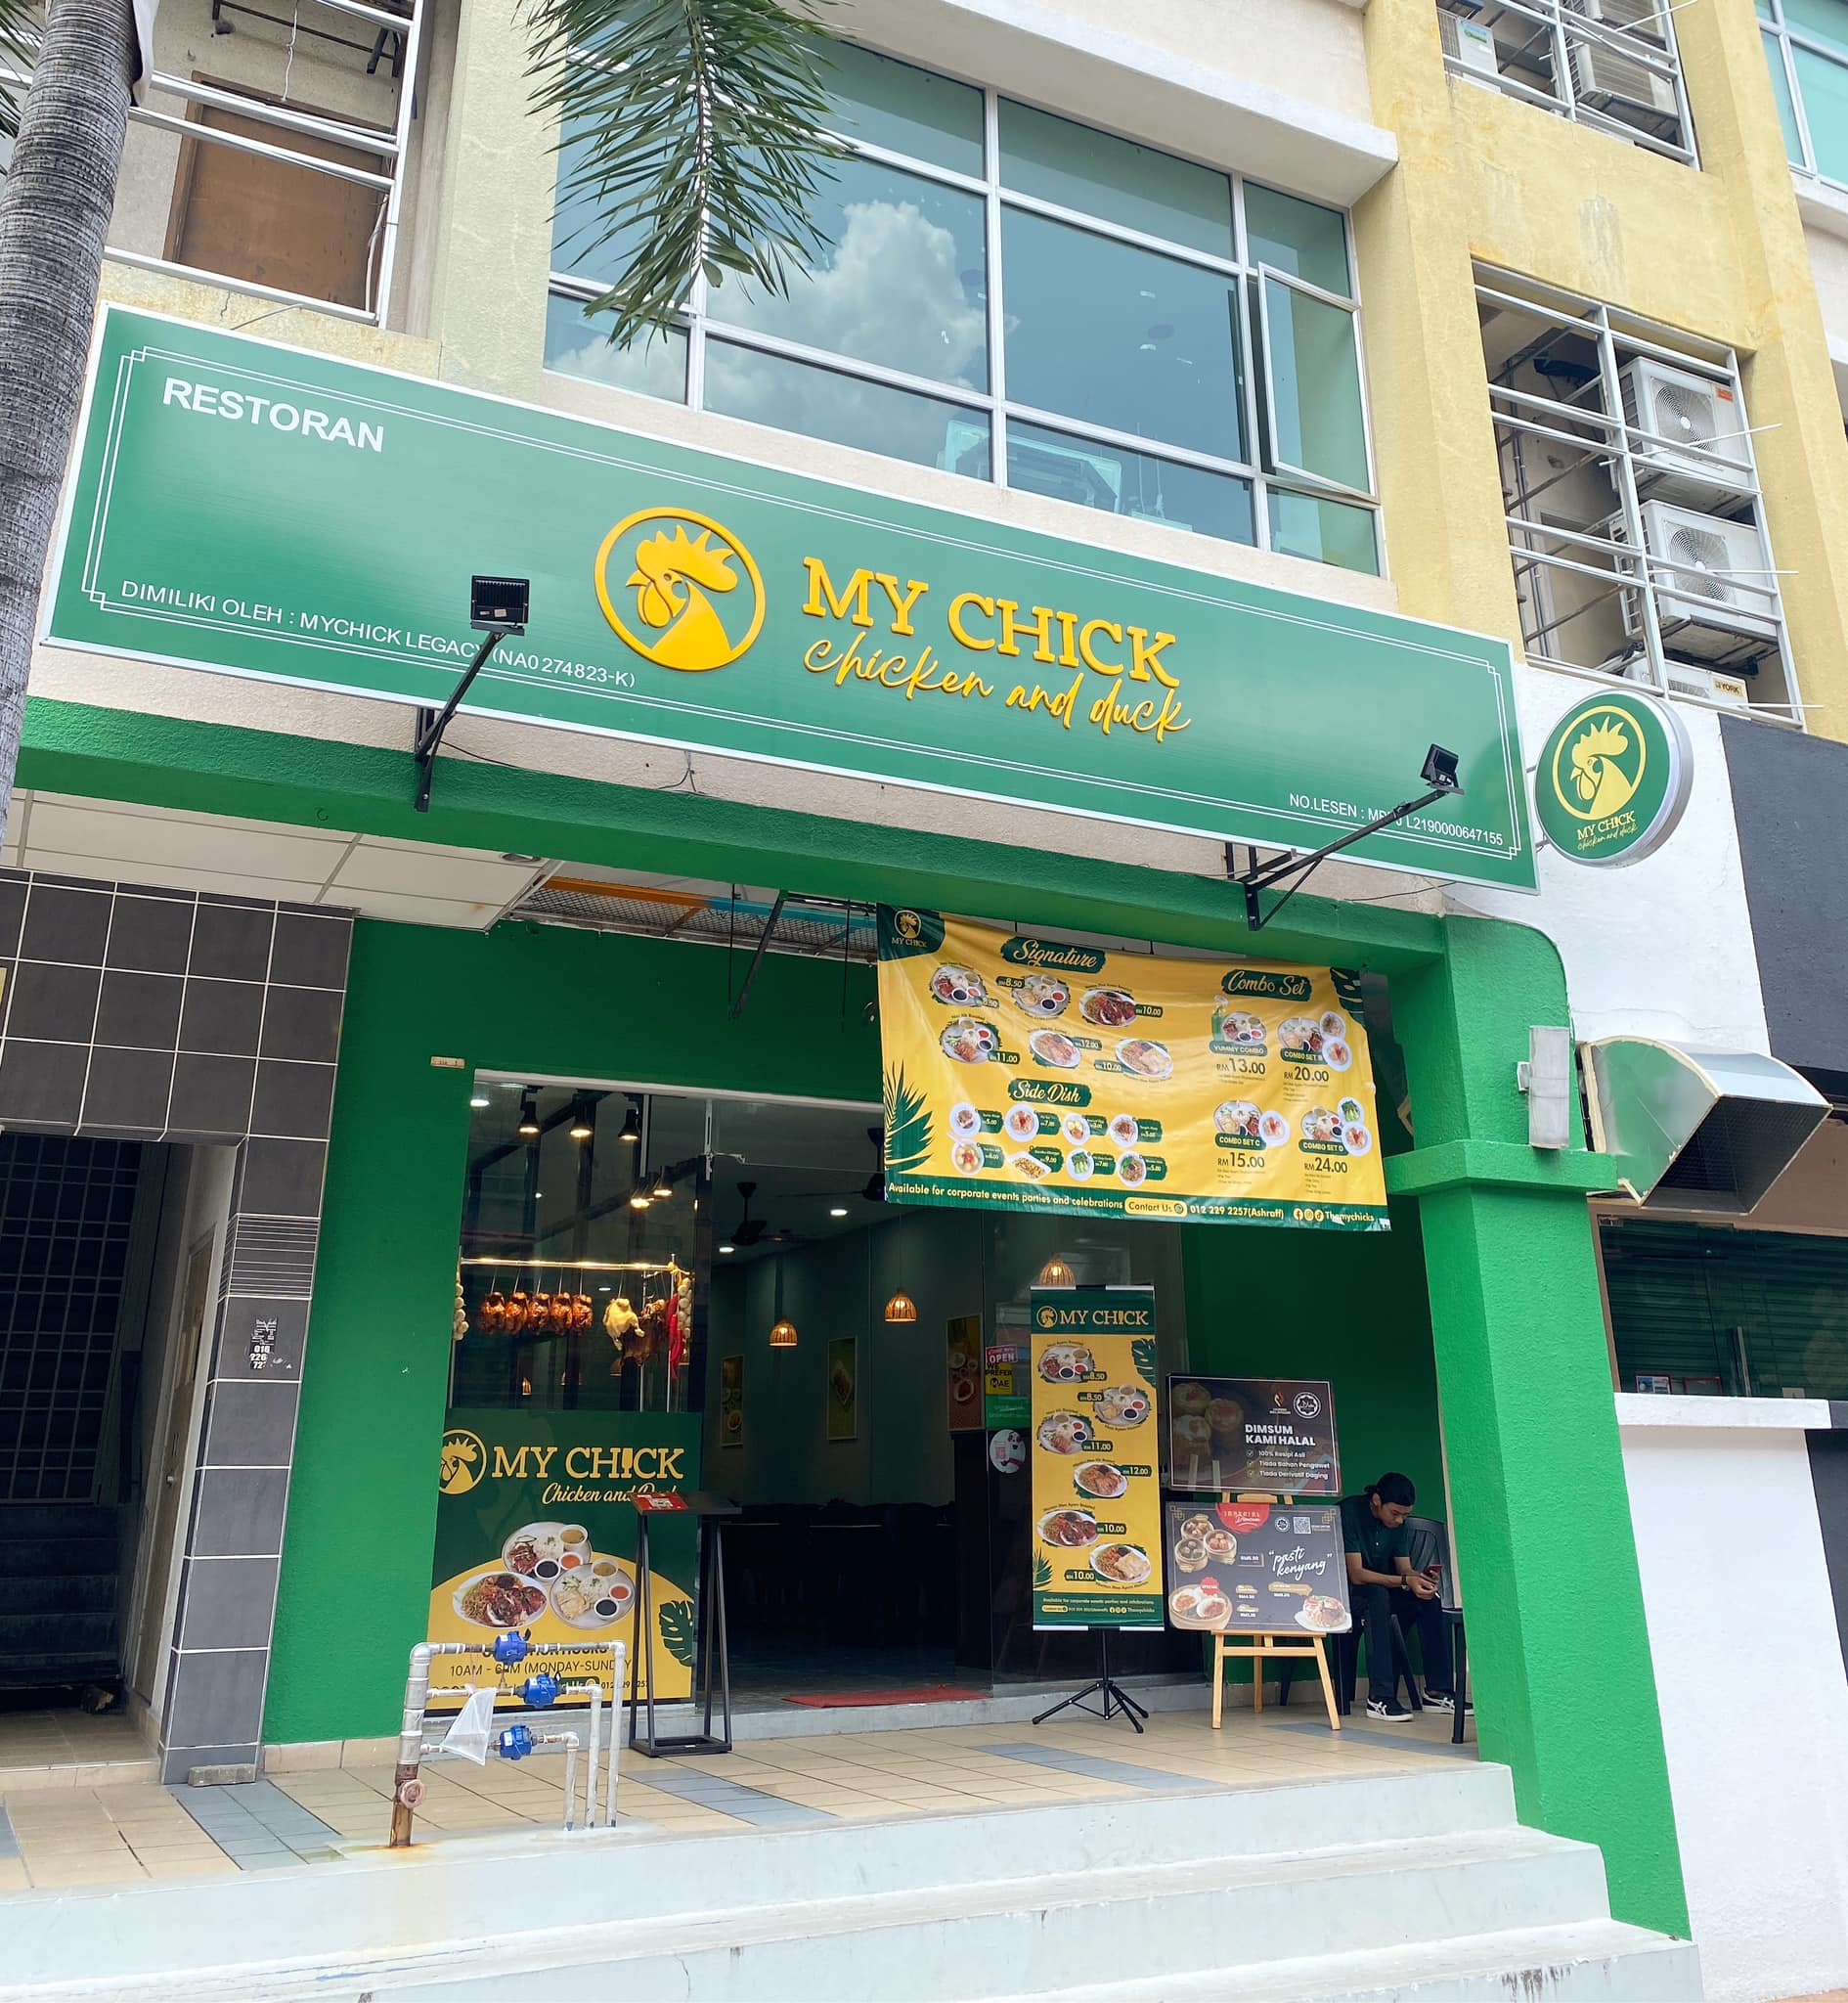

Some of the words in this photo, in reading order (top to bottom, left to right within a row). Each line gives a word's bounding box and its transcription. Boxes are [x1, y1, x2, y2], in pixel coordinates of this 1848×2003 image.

[162, 377, 384, 453] RESTORAN
[121, 580, 216, 612] DIMILIKI
[222, 599, 283, 624] OLEH
[299, 612, 402, 645] MYCHICK
[406, 631, 483, 659] LEGAC
[802, 556, 929, 637] MY
[946, 591, 1181, 688] CHICK
[1005, 671, 1082, 730] and
[1089, 678, 1192, 743] duck
[1289, 792, 1358, 818] NO.LESEN
[1406, 814, 1504, 846] L2190000647155
[1576, 823, 1597, 840] MY
[1598, 810, 1636, 833] CHICK
[891, 937, 904, 946] MY
[904, 938, 929, 949] CHICK
[1013, 939, 1098, 968] Signature
[1227, 970, 1276, 993] Combo
[1279, 975, 1308, 997] Set
[1213, 1045, 1240, 1053] YUMMY
[1240, 1046, 1265, 1055] COMBO
[1284, 1050, 1305, 1060] COMBO
[1305, 1052, 1318, 1061] SET
[1013, 1080, 1046, 1099] Side
[1046, 1083, 1081, 1103] Dish
[1218, 1135, 1243, 1145] COMBO
[1302, 1141, 1326, 1151] COMBO
[888, 1181, 930, 1195] Available
[931, 1184, 946, 1196] for
[946, 1188, 990, 1201] corporate
[991, 1192, 1020, 1202] events
[1022, 1193, 1051, 1205] parties
[1053, 1195, 1070, 1205] and
[1071, 1197, 1123, 1210] celebrations
[1128, 1200, 1161, 1213] Contact
[1162, 1203, 1173, 1214] Us
[1189, 1204, 1207, 1215] 012
[1209, 1206, 1226, 1216] 229
[1059, 1310, 1089, 1325] MY
[1092, 1310, 1149, 1326] CHICK
[989, 1354, 1016, 1363] OPEN
[1245, 1423, 1294, 1435] DIMSUM
[1245, 1434, 1278, 1445] KAMI
[1278, 1436, 1316, 1447] HALAL
[491, 1446, 558, 1479] MY
[565, 1447, 684, 1480] CHICK
[542, 1482, 602, 1505] Chicken
[450, 1664, 483, 1677] 10AM
